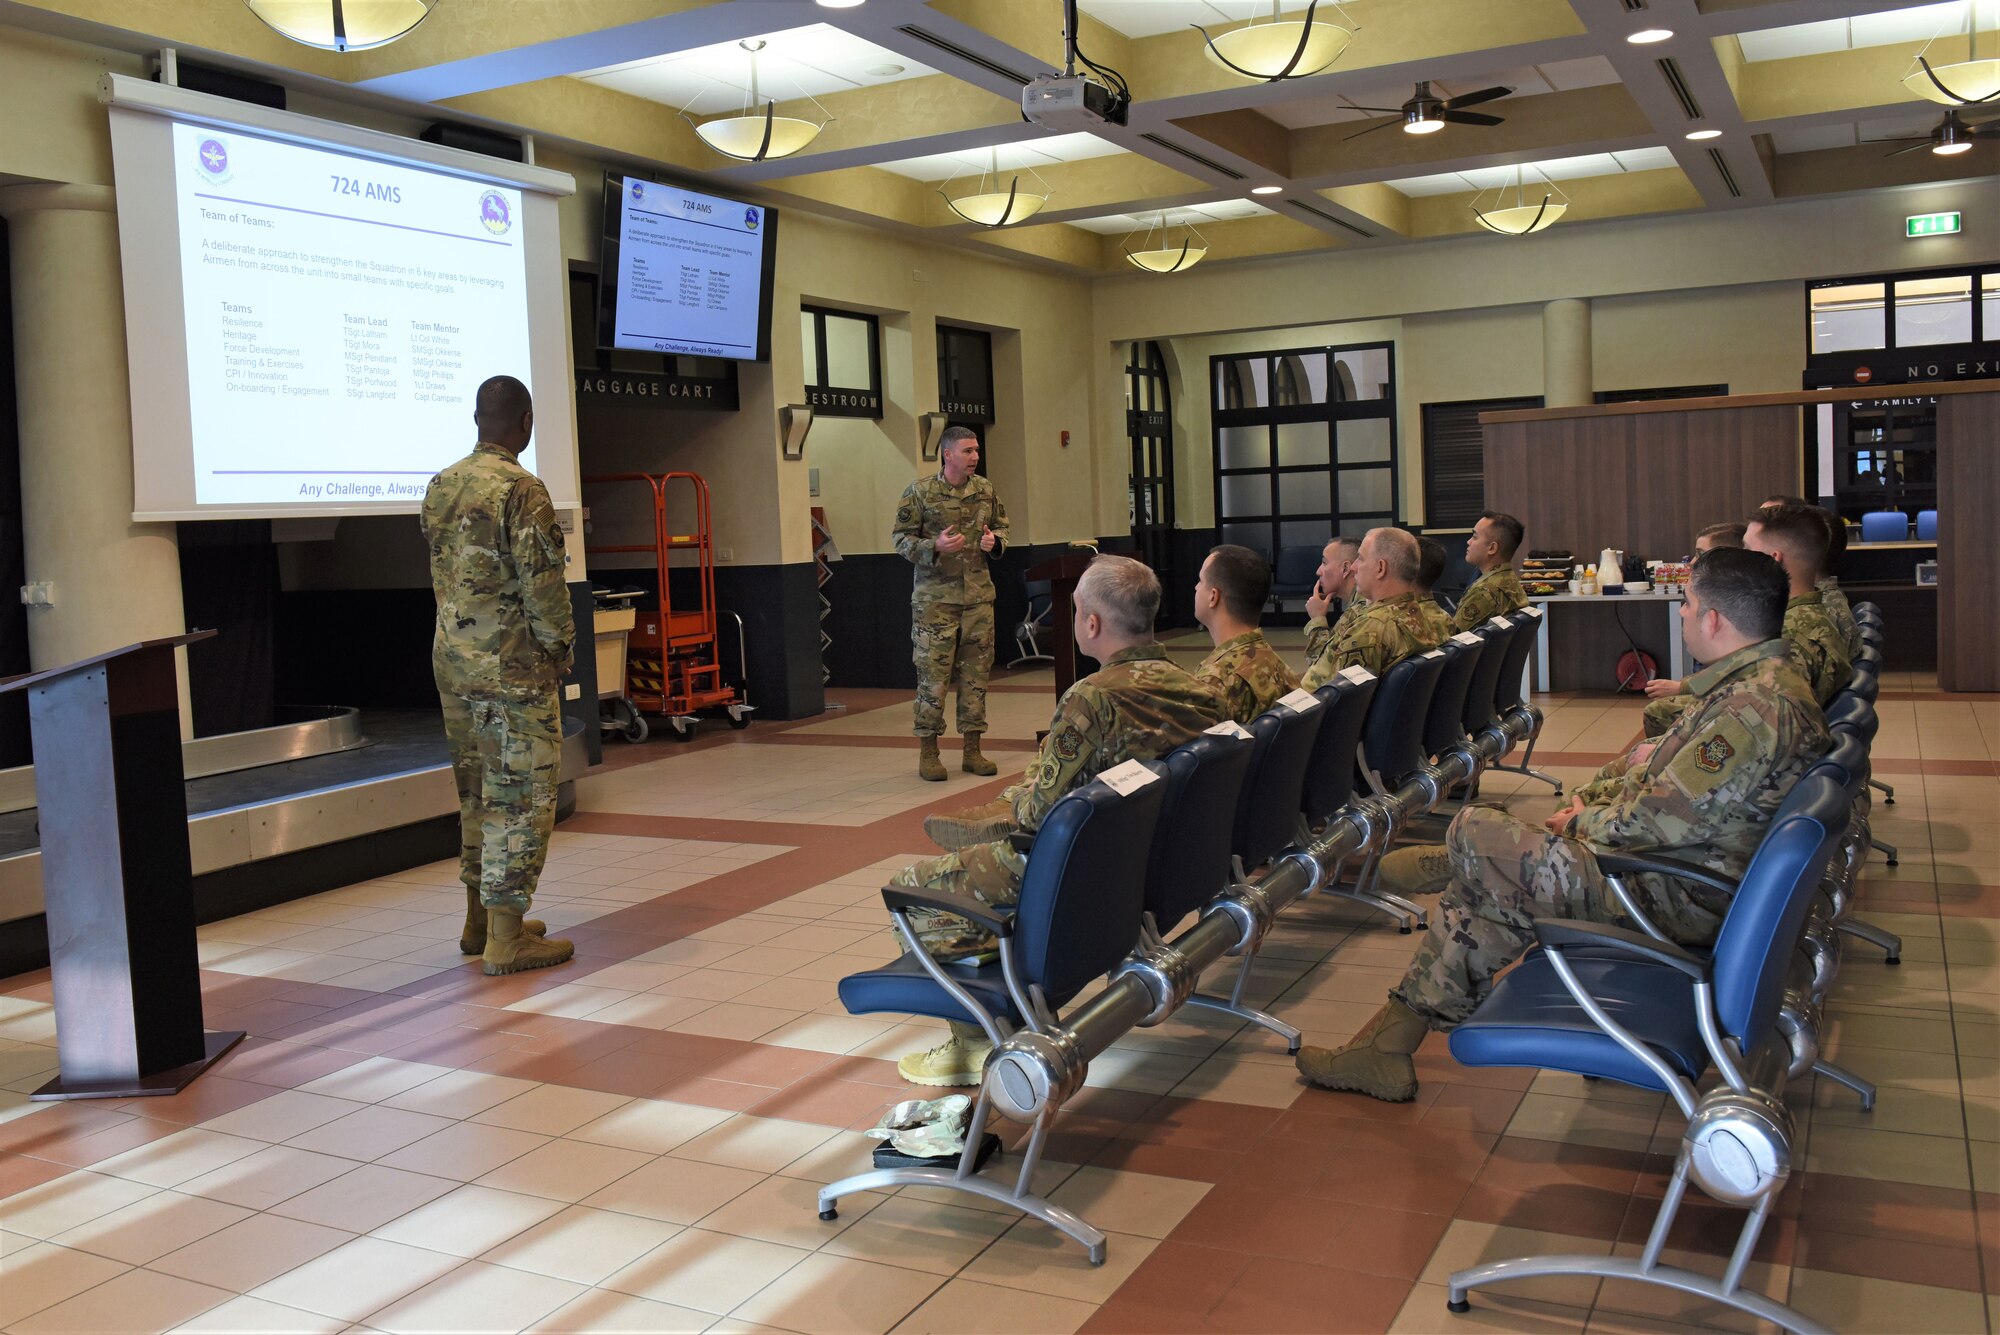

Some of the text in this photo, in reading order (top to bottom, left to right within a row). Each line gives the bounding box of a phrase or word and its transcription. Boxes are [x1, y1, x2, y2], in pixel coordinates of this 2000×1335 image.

[330, 175, 401, 204] 724 AMS
[682, 199, 712, 214] 724 AMS
[200, 208, 275, 229] Team of Teams:
[201, 238, 504, 290] A deliberate approach to strengthen the Squadron in 6 key areas by leveraging
[203, 253, 235, 267] Airmen
[238, 257, 258, 270] from
[260, 261, 289, 274] across
[291, 264, 305, 276] the
[307, 266, 322, 278] unit
[324, 268, 339, 280] into
[341, 270, 362, 282] small
[364, 274, 387, 285] teams
[388, 277, 404, 287] with
[406, 280, 434, 292] specific
[221, 301, 253, 314] Teams
[222, 316, 263, 328] Resilience
[343, 313, 388, 327] Team Lead
[343, 327, 388, 340] TSgt Latham
[411, 320, 460, 334] Team Mentor
[223, 329, 257, 342] Heritage
[411, 334, 417, 342] Lt
[419, 334, 430, 343] Col
[224, 342, 300, 357] Force Development
[344, 339, 380, 351] TSgt Mora
[411, 345, 434, 356] SMSgt
[224, 355, 304, 370] Training & Exercises
[344, 351, 363, 362] MSgt
[412, 357, 434, 368] SMSgt
[225, 368, 241, 379] CPI
[248, 370, 288, 381] Innovation
[345, 363, 362, 375] TSgt
[413, 369, 431, 380] MSgt
[1908, 364, 1939, 377] NO
[346, 375, 397, 388] TSgt Portwood
[575, 378, 712, 398] AGGAGE CART
[226, 382, 276, 396] On-boarding
[282, 384, 329, 397] Engagement
[346, 388, 364, 400] SSgt
[1874, 397, 1922, 407] FAMILY
[1148, 416, 1163, 425] EXIT
[299, 482, 425, 497] Any Challenge, Always
